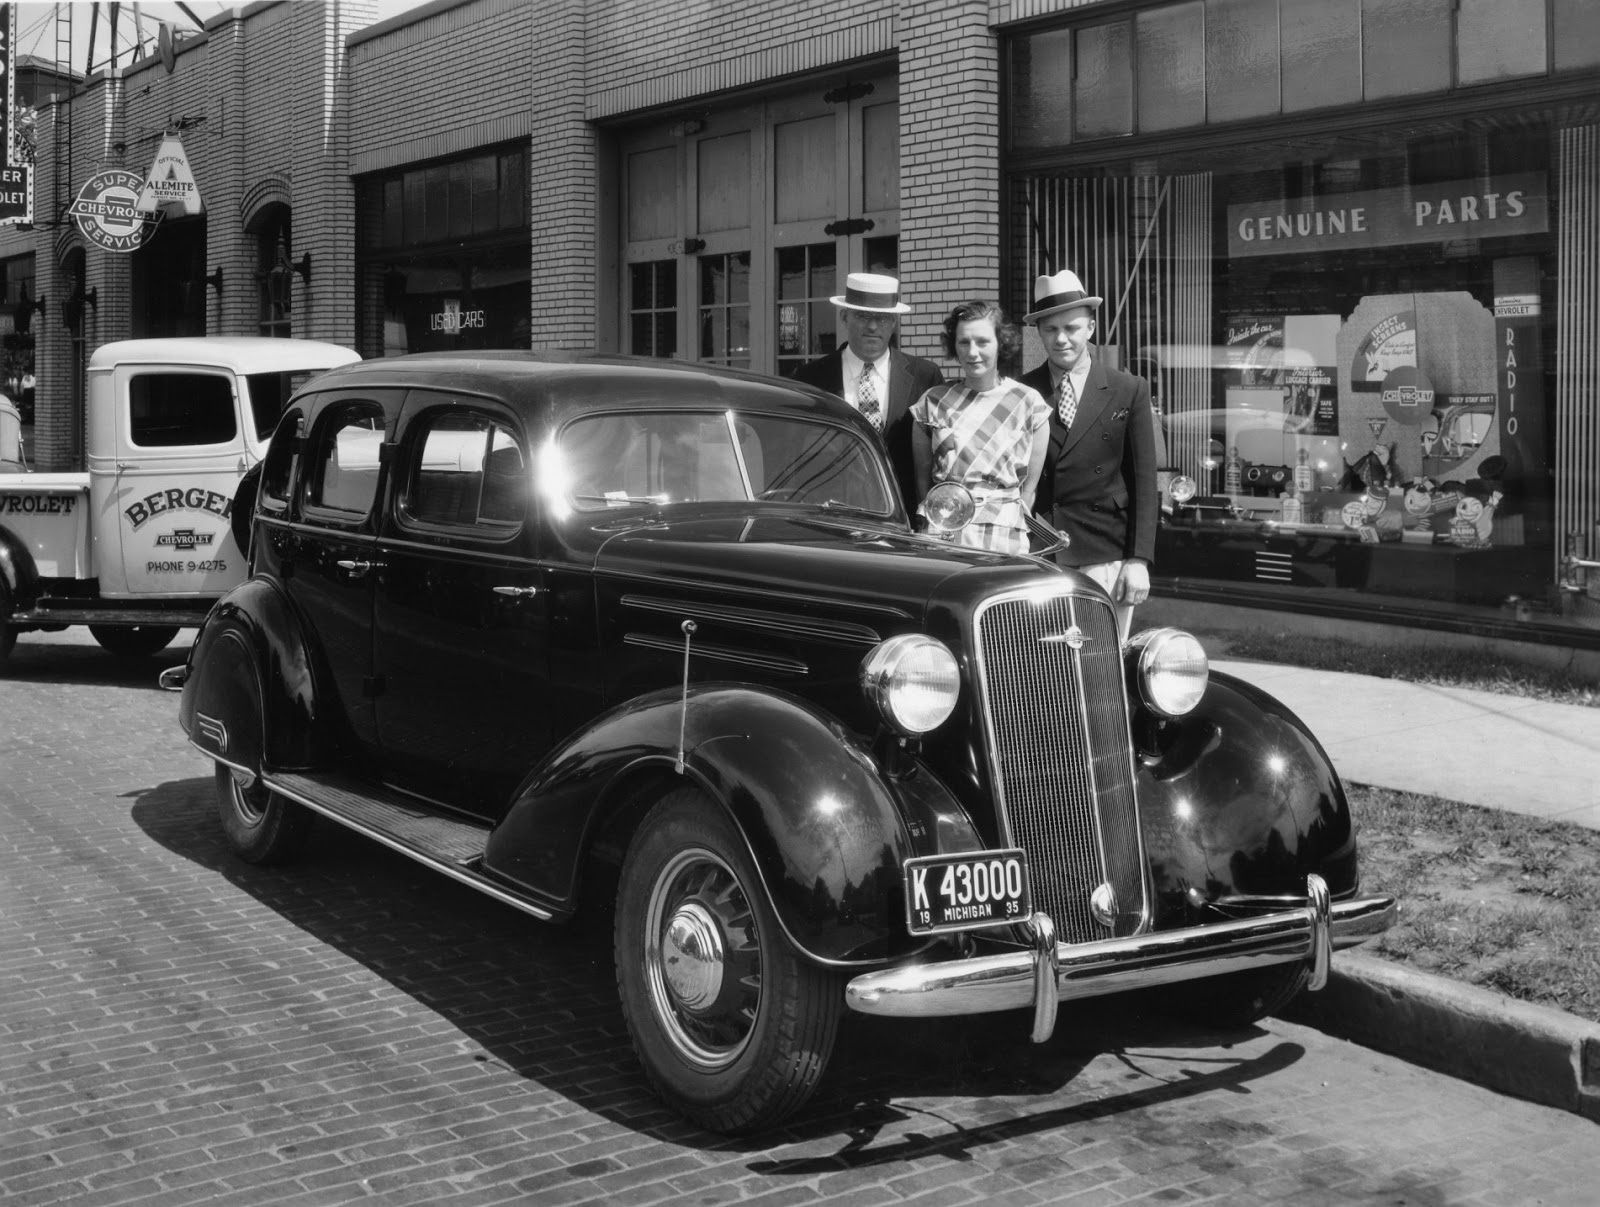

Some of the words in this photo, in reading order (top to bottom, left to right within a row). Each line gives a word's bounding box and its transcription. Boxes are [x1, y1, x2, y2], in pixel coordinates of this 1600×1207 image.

[146, 180, 194, 191] ALEMITE
[1238, 207, 1367, 242] GENUINE
[1415, 190, 1525, 227] PARTS
[430, 312, 455, 331] USED
[457, 310, 484, 329] CARS
[1371, 315, 1398, 339] INSECT
[1372, 321, 1408, 349] SCREENS
[1285, 376, 1308, 384] LUGGAGE
[1308, 376, 1331, 385] CARRIER
[1505, 327, 1519, 436] RADIO
[1386, 391, 1432, 400] CHEVROLET
[159, 535, 210, 545] CHEVROLET
[147, 560, 184, 572] PHONE
[912, 868, 930, 910] K
[940, 859, 1022, 906] 43000
[919, 911, 931, 924] 19
[944, 903, 992, 921] MICHIGAN
[1006, 901, 1019, 914] 35
